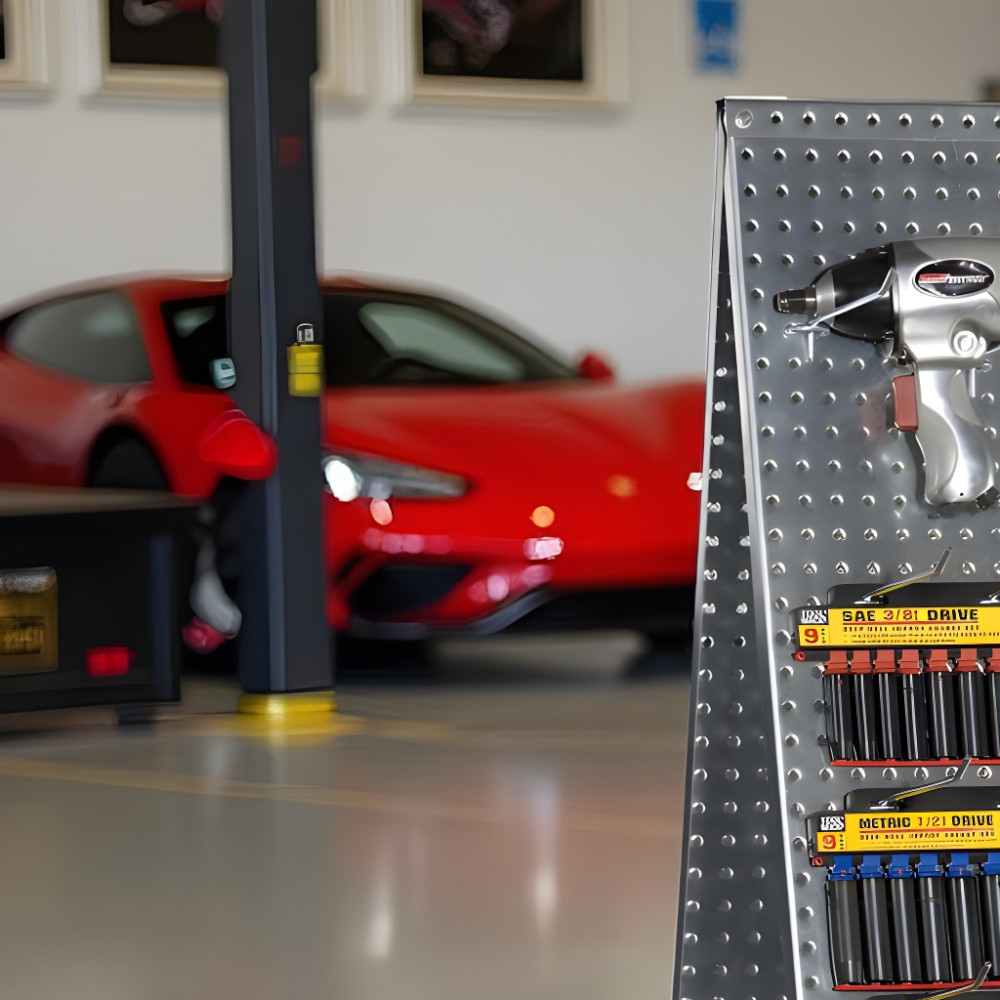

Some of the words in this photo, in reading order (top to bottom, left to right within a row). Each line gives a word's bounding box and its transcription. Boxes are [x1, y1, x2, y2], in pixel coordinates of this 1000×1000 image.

[843, 610, 875, 622] SAE
[927, 609, 978, 621] DRIVE
[804, 628, 818, 643] 9
[822, 834, 836, 850] 9
